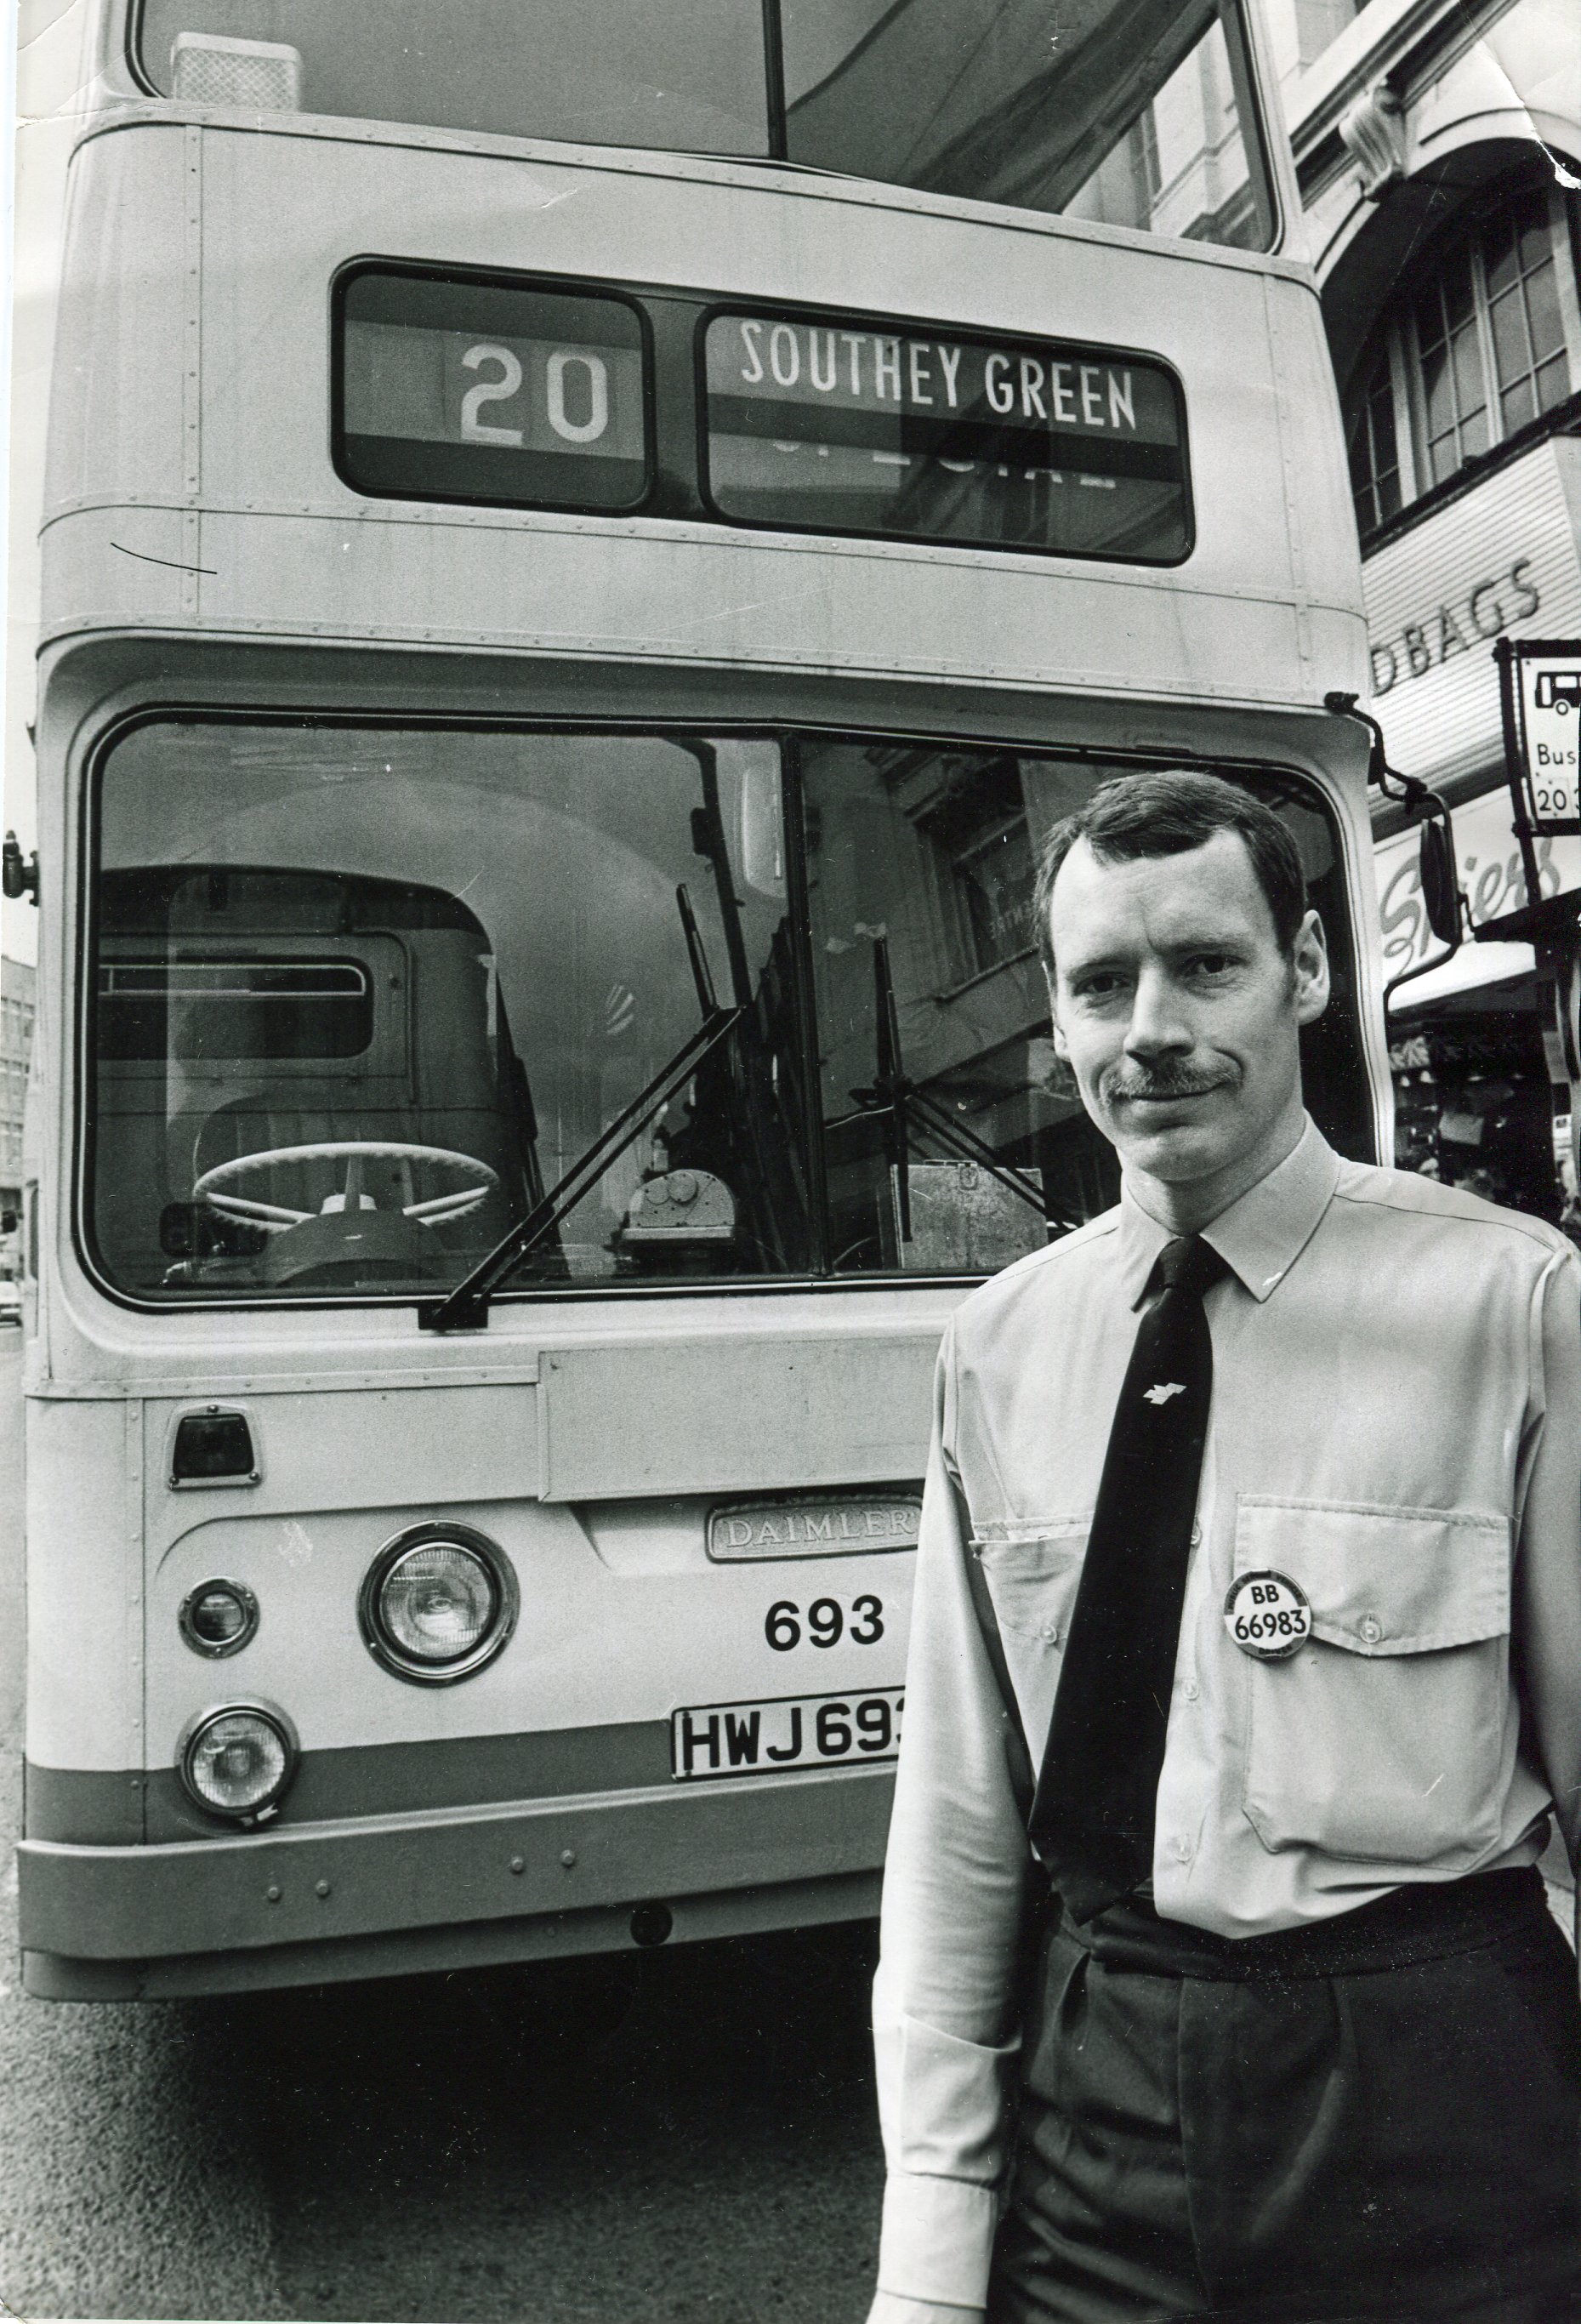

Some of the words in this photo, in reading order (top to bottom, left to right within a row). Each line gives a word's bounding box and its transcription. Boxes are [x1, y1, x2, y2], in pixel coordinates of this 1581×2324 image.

[740, 320, 961, 408] SOUTHEY
[985, 353, 1136, 430] GREEN
[460, 342, 609, 447] 20
[1537, 743, 1577, 766] Bus
[1537, 789, 1567, 812] 20
[725, 1508, 916, 1549] DAIMLER
[1250, 1584, 1280, 1605] BB
[765, 1594, 885, 1652] 693
[1234, 1609, 1307, 1641] 66983
